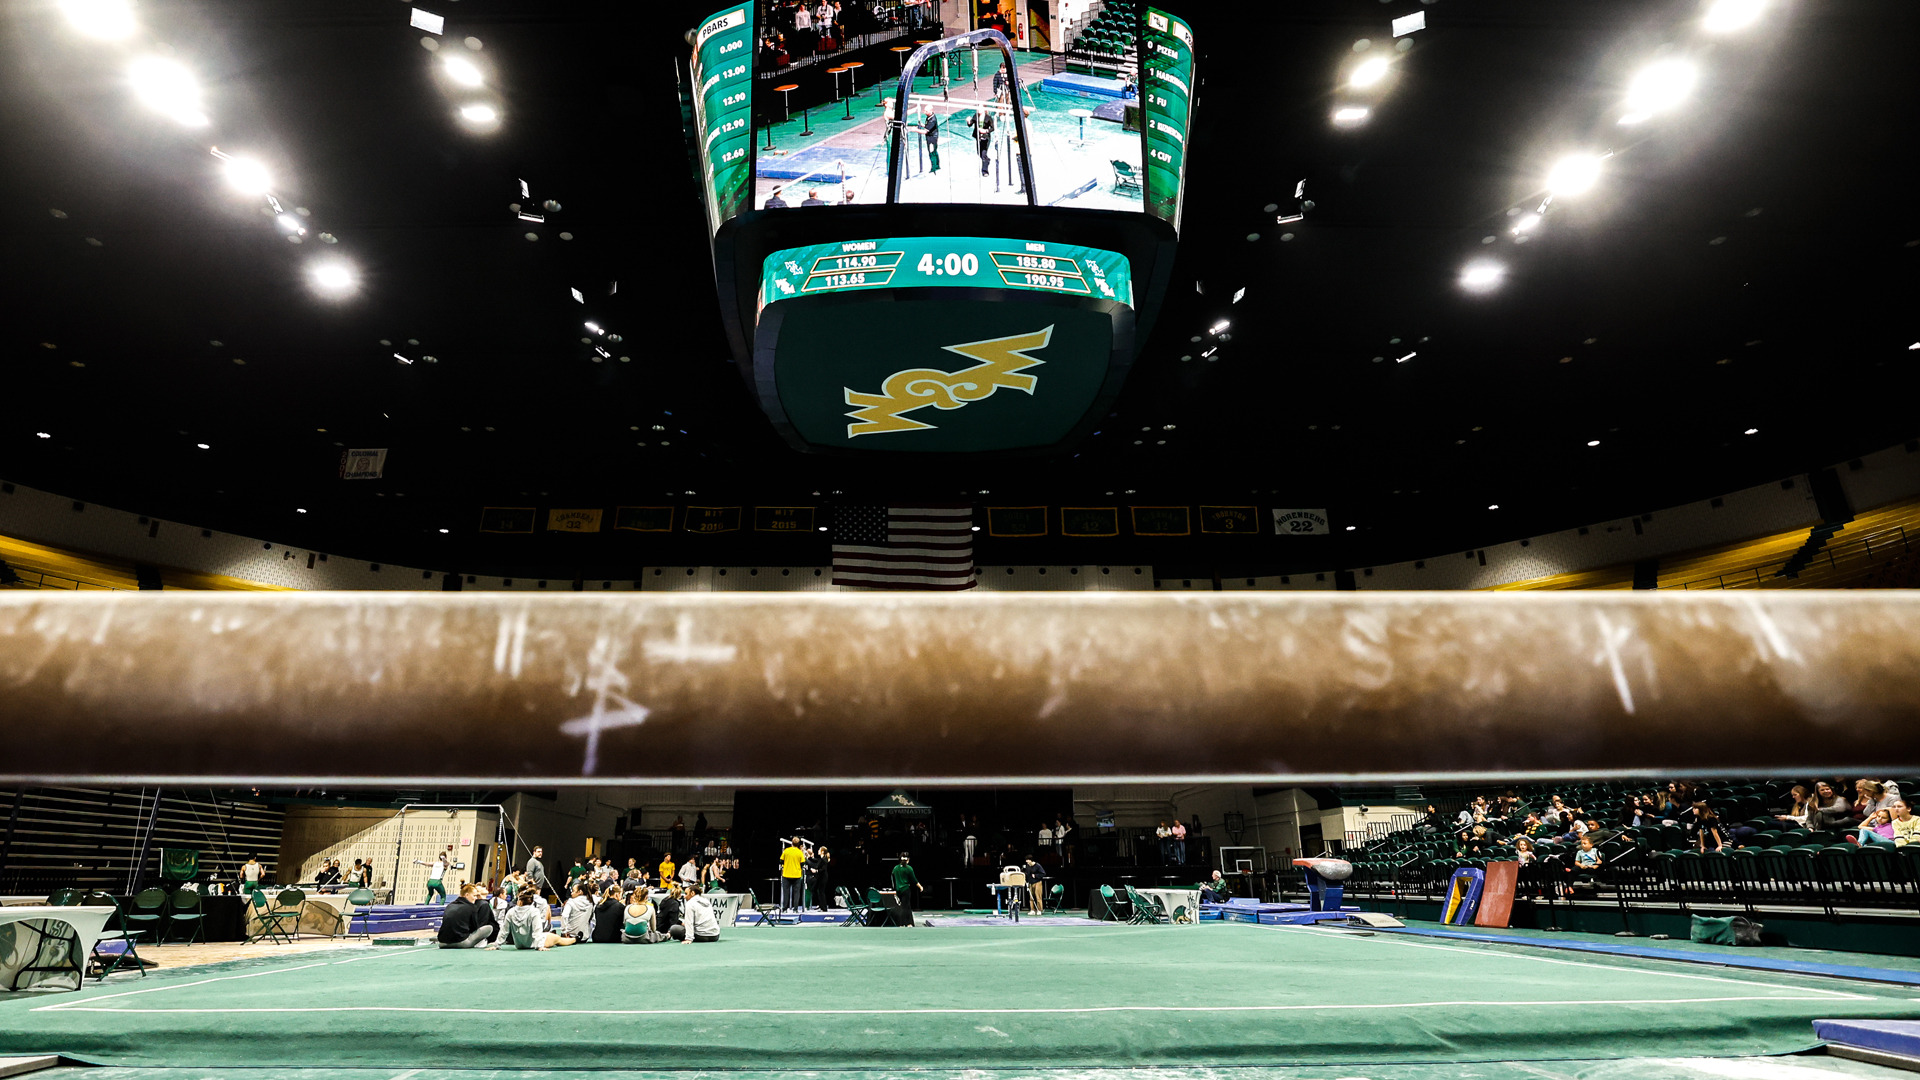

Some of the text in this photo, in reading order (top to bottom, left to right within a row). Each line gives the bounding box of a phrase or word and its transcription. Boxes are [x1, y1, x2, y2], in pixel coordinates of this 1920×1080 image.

[702, 17, 729, 38] PBARS
[719, 39, 743, 55] 0.000
[1147, 40, 1179, 60] 0 PIZEM
[722, 64, 746, 80] 13.00
[1149, 67, 1155, 76] 1
[722, 91, 746, 107] 12.90
[1148, 94, 1167, 107] 2 FU
[721, 118, 745, 134] 12.90
[1149, 119, 1156, 128] 2
[721, 147, 745, 163] 12.60
[1150, 149, 1173, 164] 4 CUY
[841, 241, 877, 252] WOMEN
[1025, 242, 1046, 253] MEN
[835, 255, 877, 269] 114.90
[916, 252, 980, 276] 4:00
[1015, 255, 1057, 270] 185.80
[824, 272, 866, 287] 113.65
[1024, 273, 1066, 288] 190.95
[1225, 518, 1234, 530] 3
[1276, 511, 1326, 526] NORENBERG
[1290, 521, 1314, 532] 22
